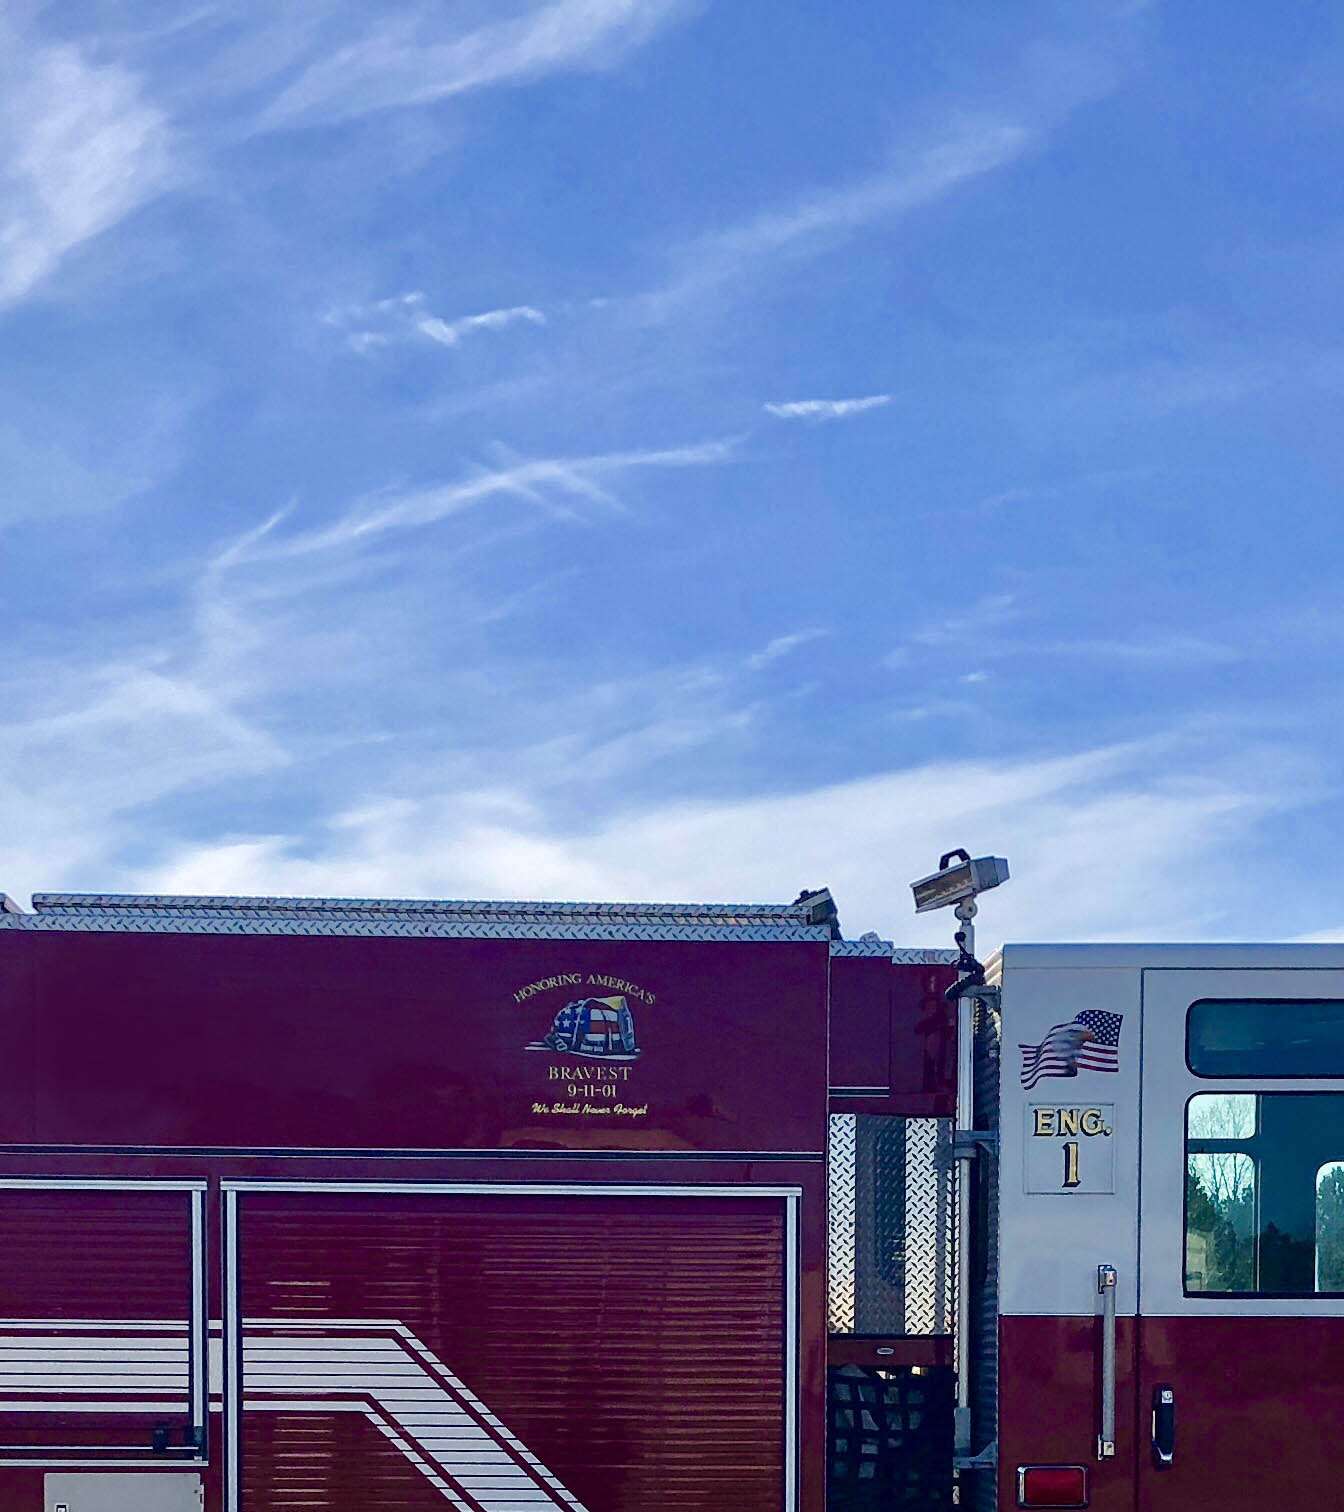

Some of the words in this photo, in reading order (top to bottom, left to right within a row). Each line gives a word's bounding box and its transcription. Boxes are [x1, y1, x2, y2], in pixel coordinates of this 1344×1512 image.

[513, 973, 582, 1003] HONORING
[586, 974, 656, 1005] AMERICA'S
[548, 1066, 633, 1081] BRAVEST
[567, 1083, 617, 1098] 9-11-01
[531, 1103, 549, 1114] We
[551, 1103, 580, 1114] Shall
[582, 1103, 611, 1114] Never
[613, 1103, 648, 1118] Forget
[1033, 1108, 1113, 1137] ENG.
[1062, 1142, 1081, 1188] 1
